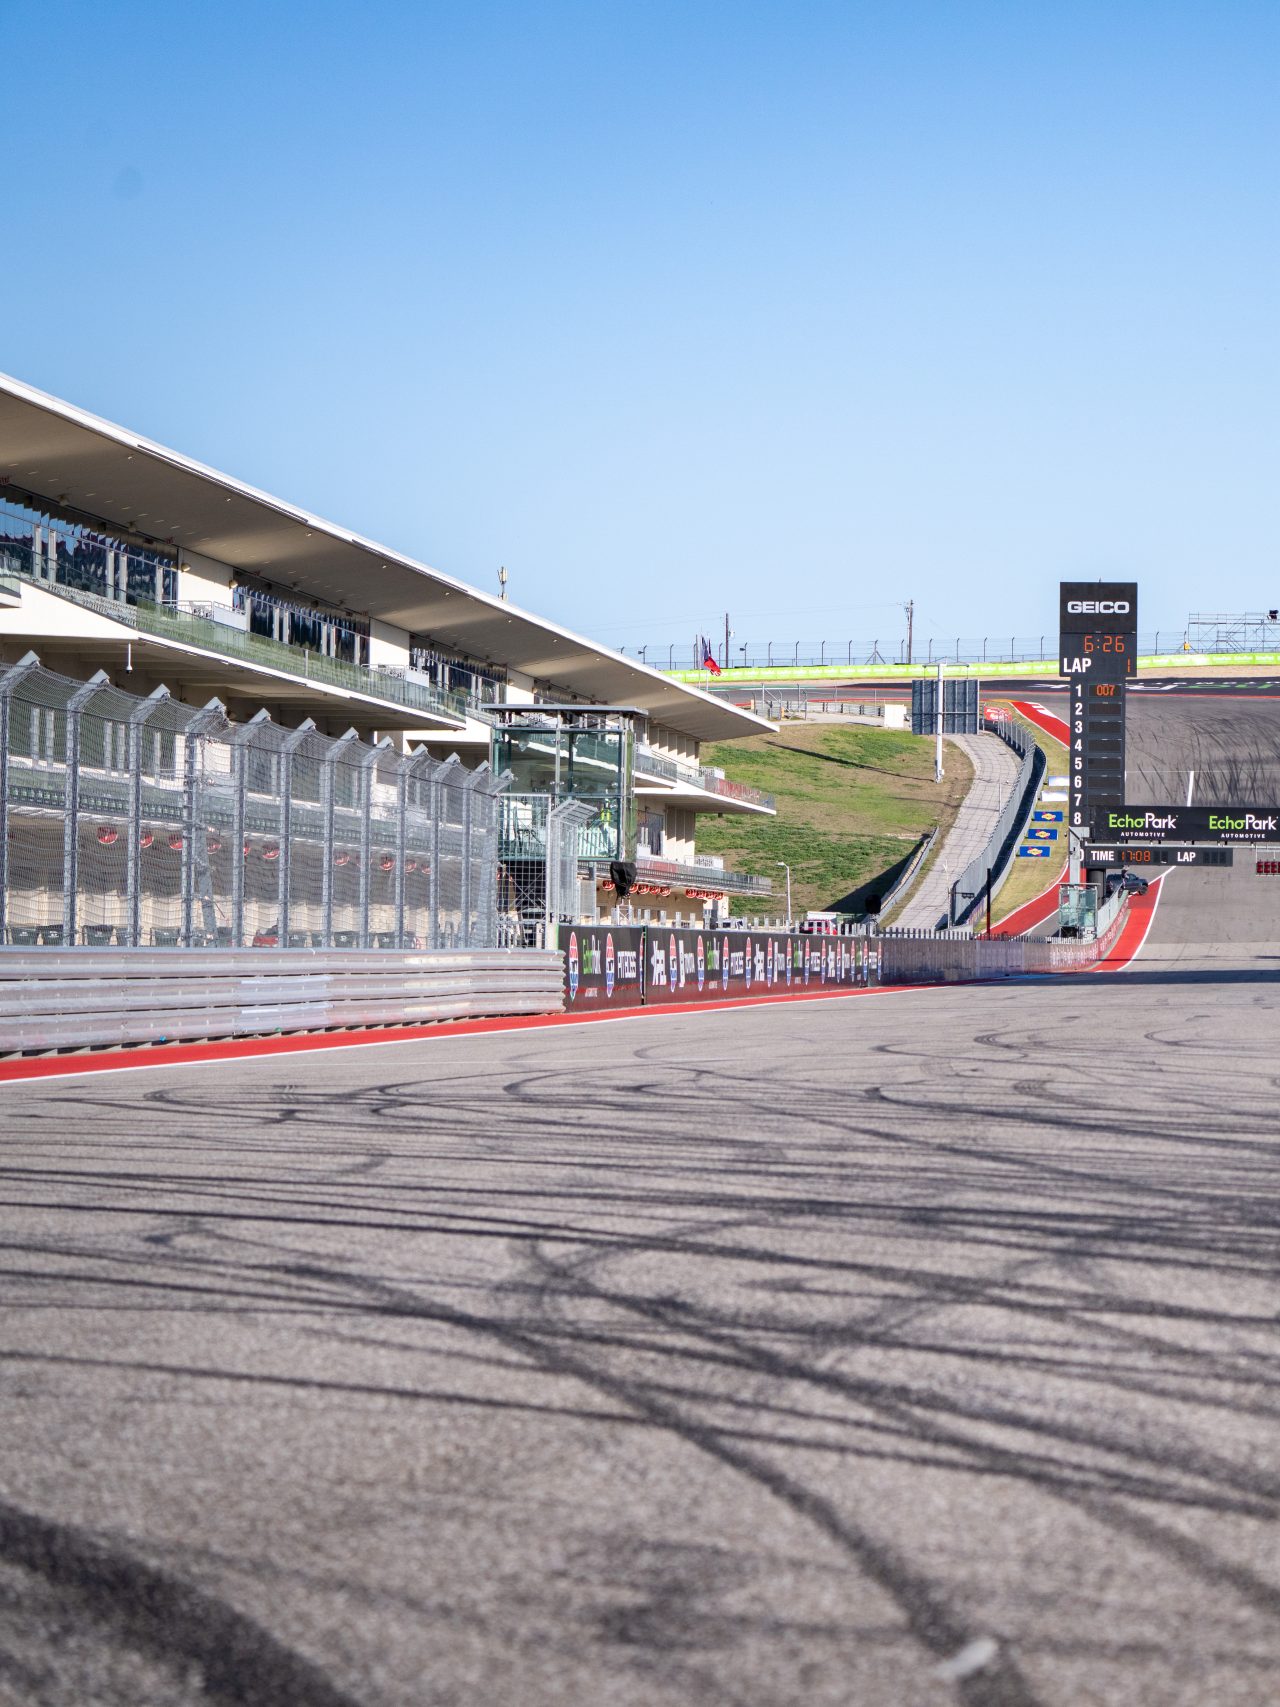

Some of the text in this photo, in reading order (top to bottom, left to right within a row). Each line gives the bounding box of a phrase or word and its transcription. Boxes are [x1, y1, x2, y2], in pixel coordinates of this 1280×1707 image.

[1067, 601, 1130, 614] GEICO
[1084, 636, 1125, 653] 6:26
[1064, 658, 1092, 672] LAP
[1127, 656, 1130, 672] 1
[1076, 684, 1115, 697] 1 007
[1075, 702, 1082, 715] 2
[1075, 721, 1082, 733] 3
[1074, 739, 1082, 751] 4
[1074, 757, 1082, 769] 5
[1074, 775, 1082, 788] 6
[1074, 794, 1082, 806] 7
[1074, 812, 1082, 825] 8
[1109, 813, 1177, 829] EchoPark
[1209, 814, 1277, 830] EchoPark
[1090, 850, 1196, 862] TIME 17:08 LAP
